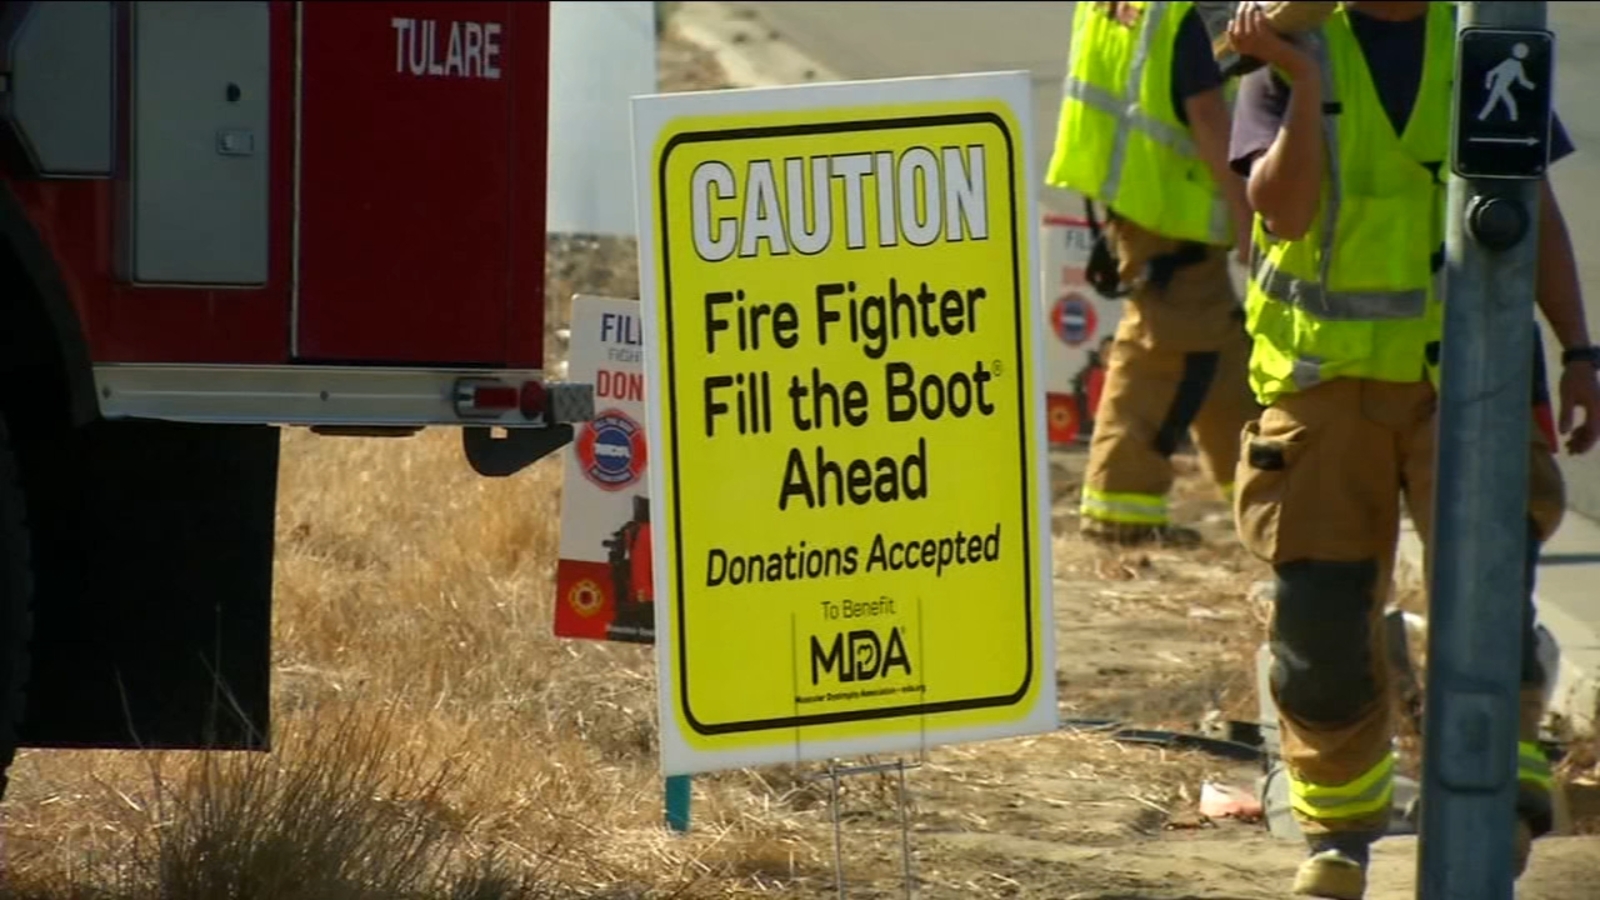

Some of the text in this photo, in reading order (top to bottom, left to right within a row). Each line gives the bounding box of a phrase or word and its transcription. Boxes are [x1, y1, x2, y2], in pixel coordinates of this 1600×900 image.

[391, 17, 501, 79] TULARE
[690, 144, 989, 262] CAUTION
[704, 277, 986, 359] Fire Fighter
[596, 370, 643, 401] DON
[704, 371, 771, 438] Fill
[788, 367, 868, 431] the
[778, 437, 927, 511] Ahead
[706, 523, 1000, 587] Donations Accepted
[821, 596, 897, 620] To Benefit
[810, 626, 912, 686] MDA
